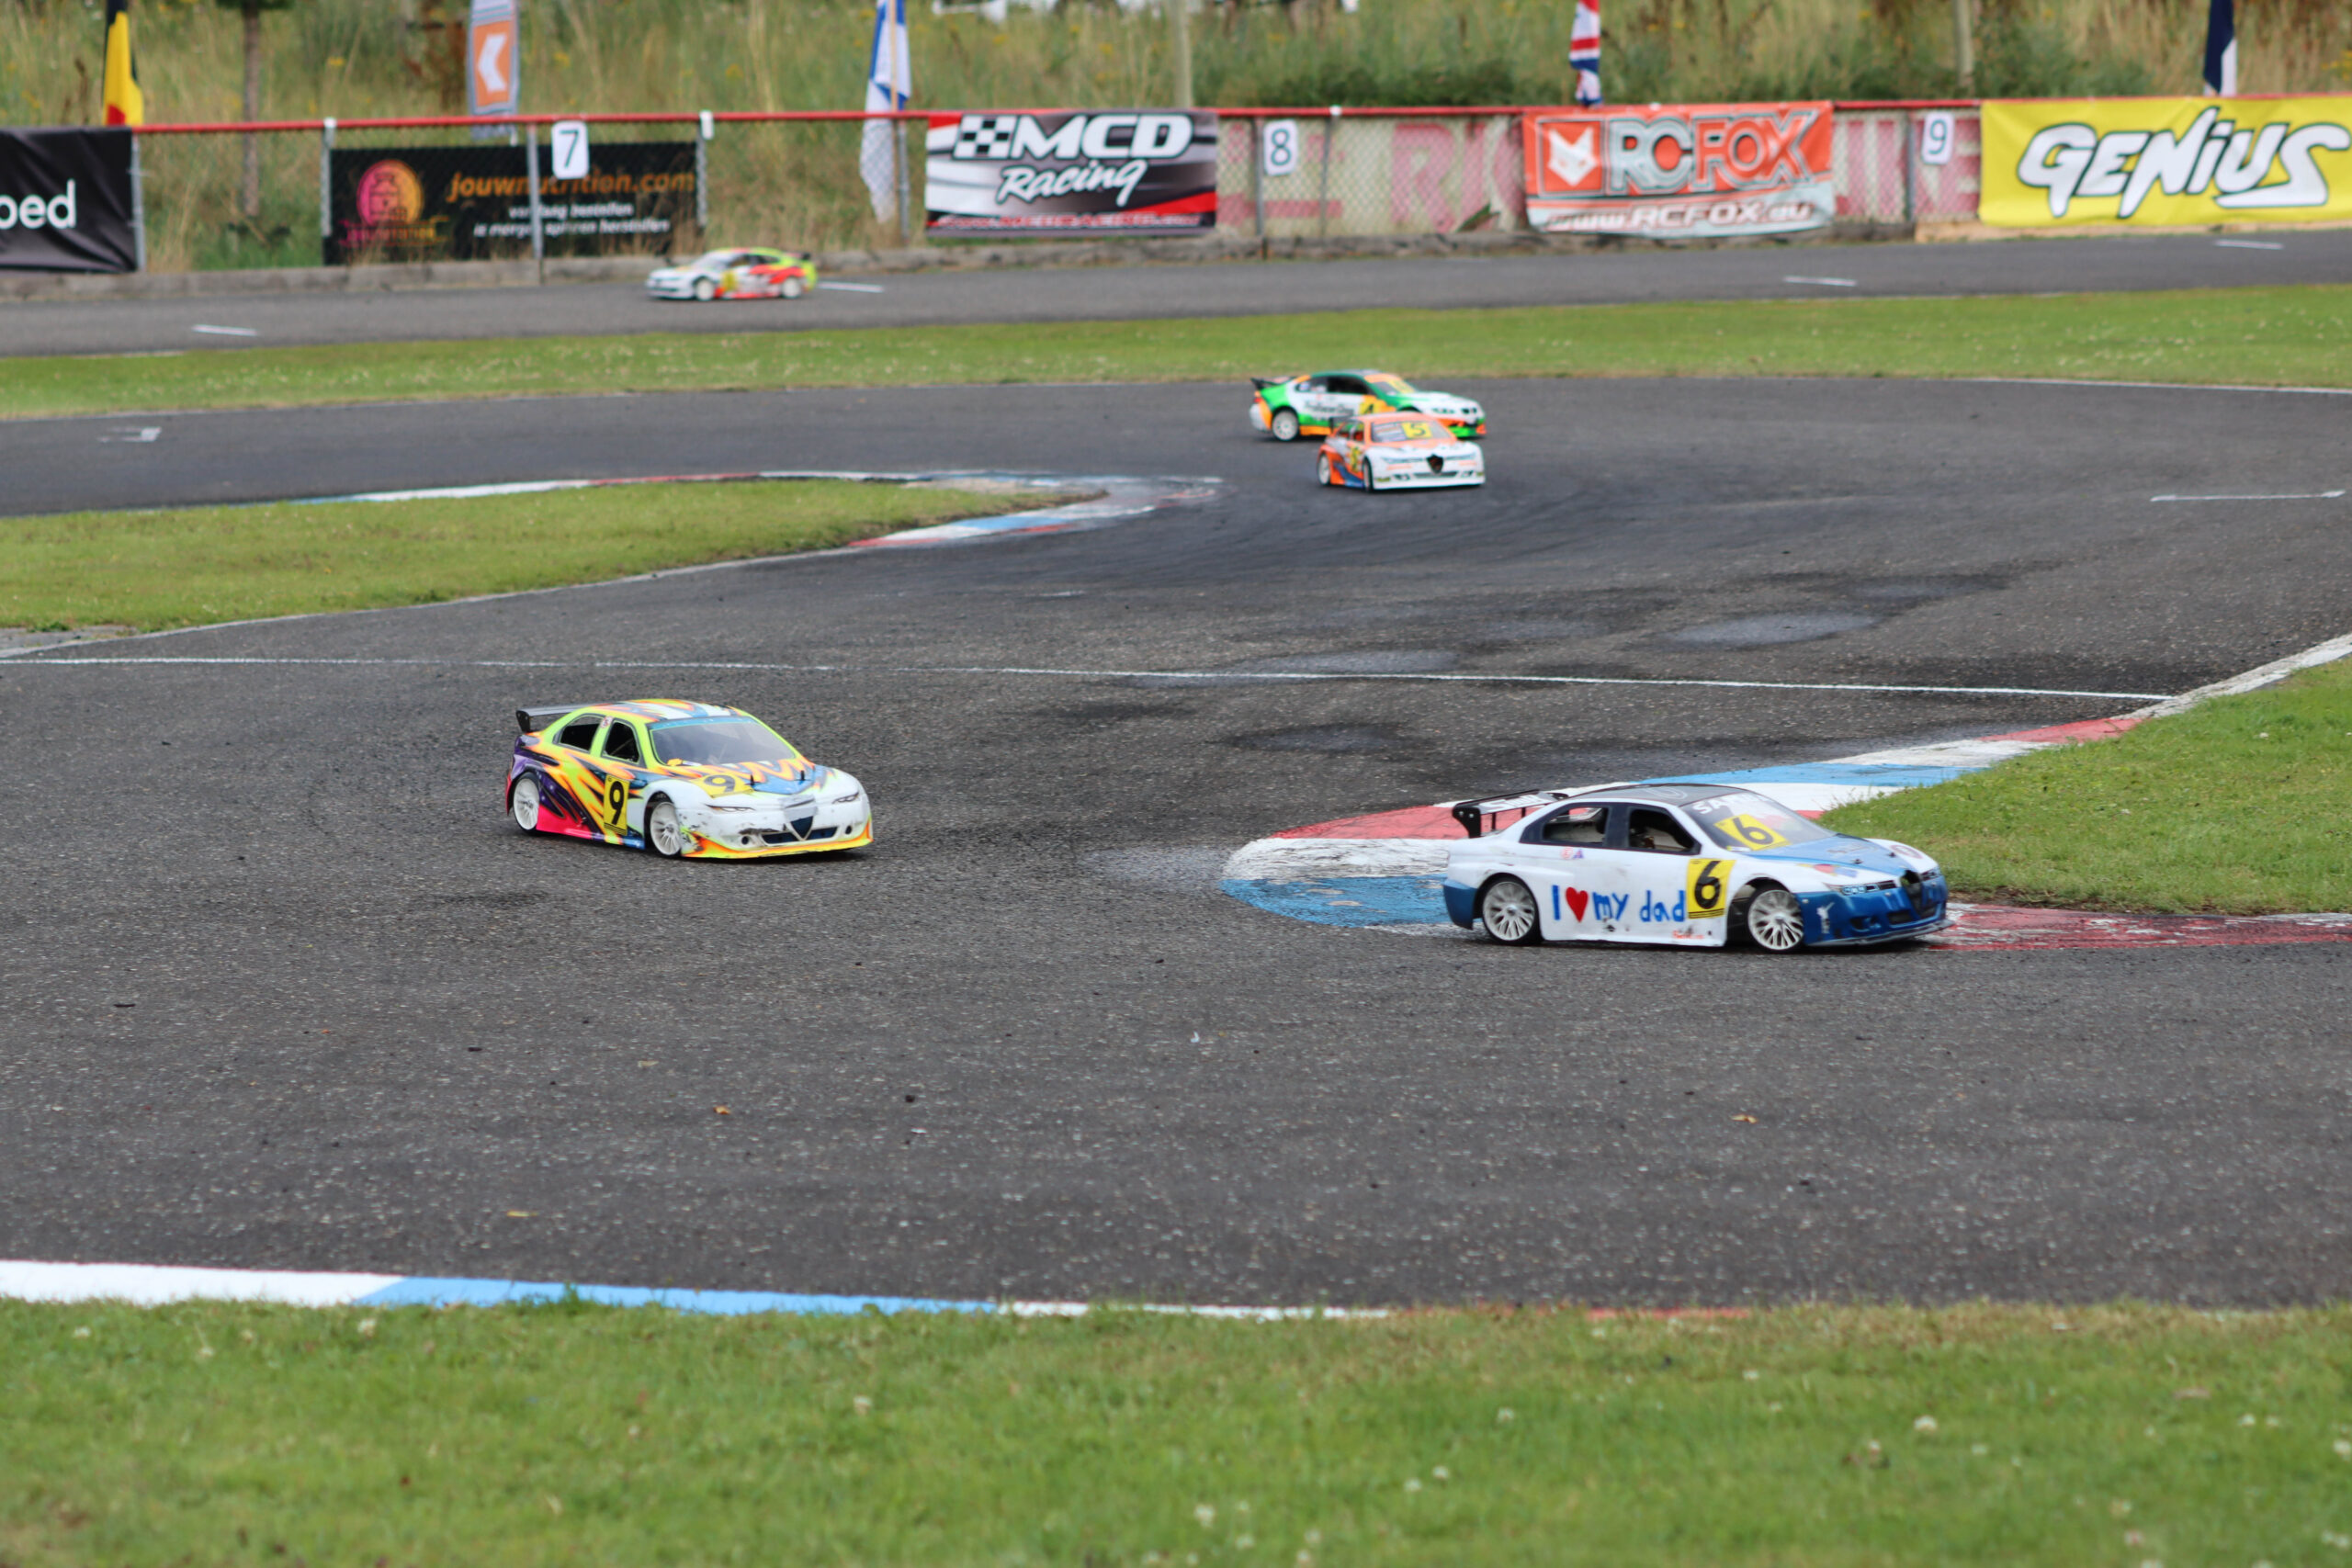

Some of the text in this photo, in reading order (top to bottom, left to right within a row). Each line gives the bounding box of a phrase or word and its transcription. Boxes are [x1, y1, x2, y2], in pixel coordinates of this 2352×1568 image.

[559, 129, 581, 169] 7
[1009, 113, 1193, 160] MCD
[1270, 128, 1292, 166] 8
[1928, 118, 1948, 155] 9
[995, 158, 1148, 208] Racing
[1410, 422, 1426, 437] 5
[704, 773, 736, 794] 9
[609, 781, 625, 826] 9
[1732, 816, 1774, 845] 6
[1694, 860, 1722, 909] 6
[1552, 885, 1560, 921] I
[1639, 889, 1685, 923] dad
